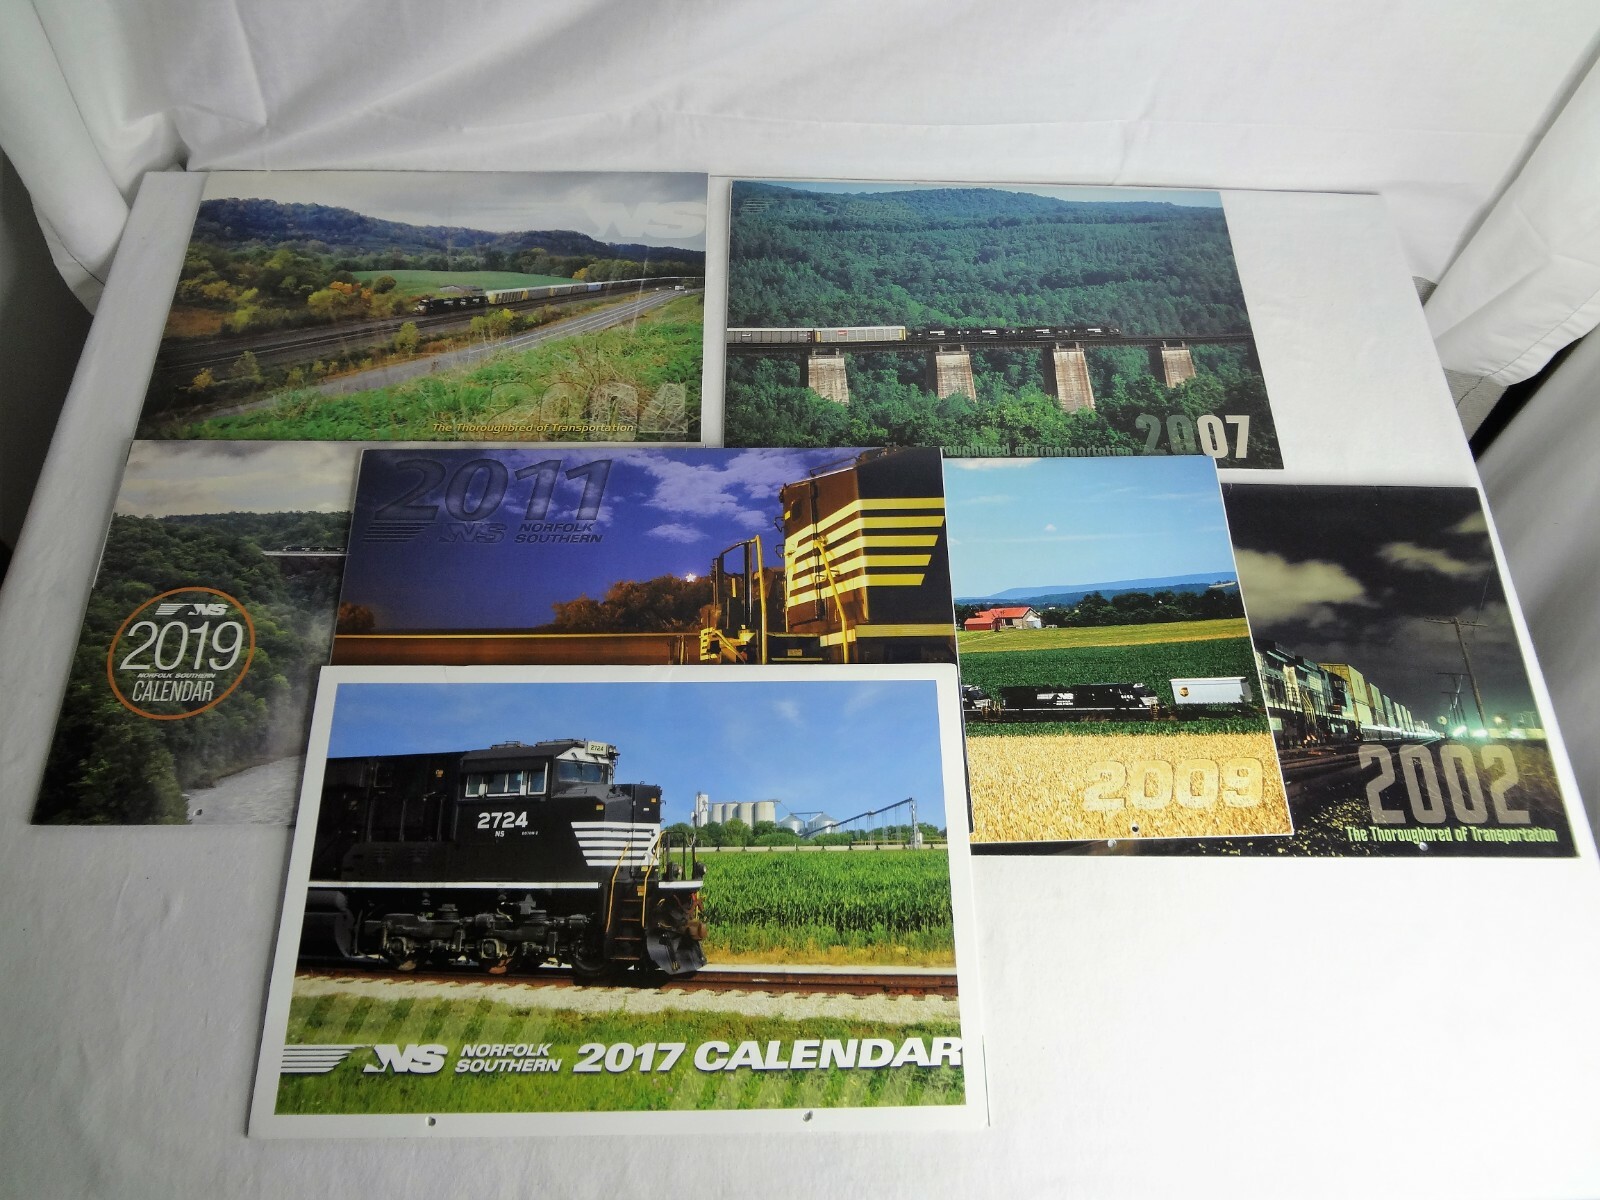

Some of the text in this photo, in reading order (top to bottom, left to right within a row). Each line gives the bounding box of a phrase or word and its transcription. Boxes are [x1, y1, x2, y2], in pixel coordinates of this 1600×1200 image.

[432, 423, 635, 434] The Thoroughbred of Transportation
[1136, 414, 1250, 458] 2007
[374, 458, 612, 521] 2011
[518, 523, 596, 533] NORFOLK
[513, 533, 604, 543] SOUTHERN
[187, 603, 229, 616] NS
[119, 620, 244, 671] 2019
[132, 680, 214, 702] CALENDAR
[1082, 757, 1265, 812] 2009
[1357, 744, 1532, 825] 2002
[477, 811, 529, 830] 2724
[494, 830, 505, 838] NS
[1345, 826, 1559, 845] The Thoroughbred of Transportation
[363, 1043, 448, 1074] NS
[460, 1042, 553, 1058] NORFOLK
[572, 1036, 963, 1073] 2017 CALENDAR
[454, 1058, 562, 1073] SOUTHERN
